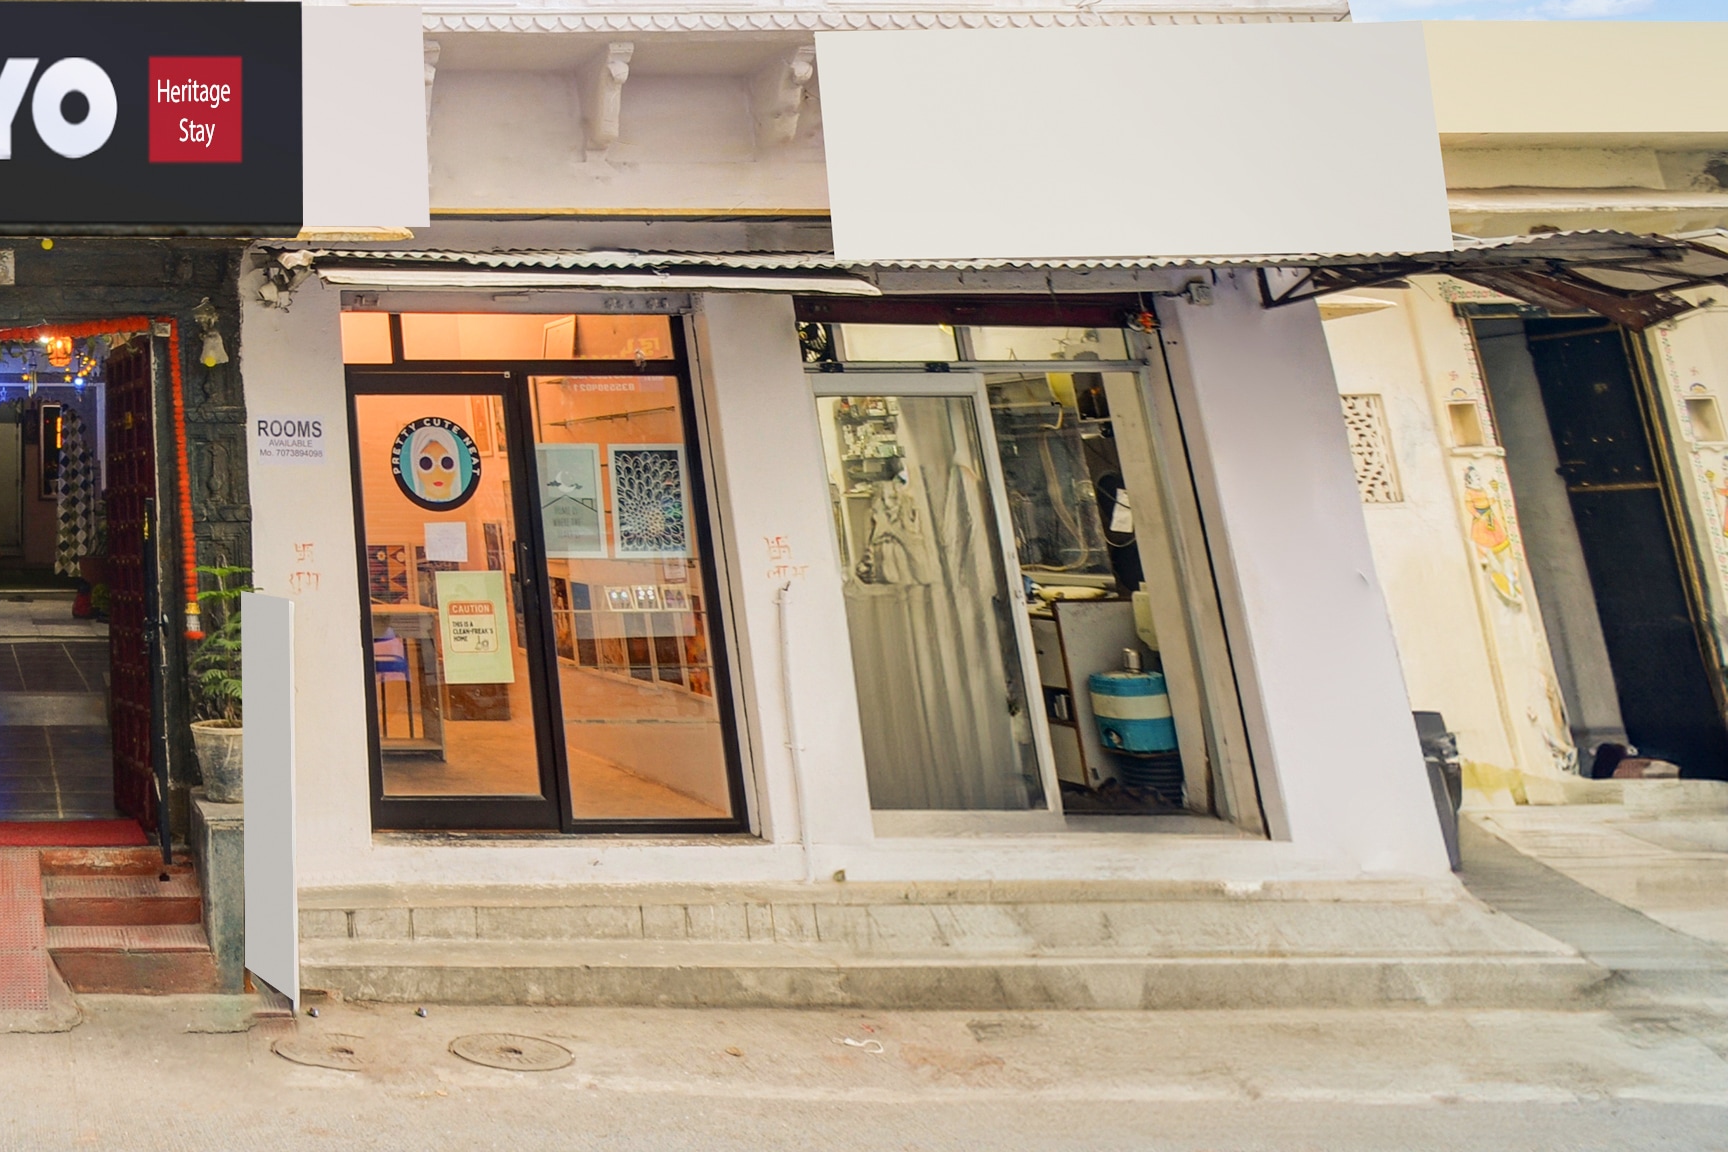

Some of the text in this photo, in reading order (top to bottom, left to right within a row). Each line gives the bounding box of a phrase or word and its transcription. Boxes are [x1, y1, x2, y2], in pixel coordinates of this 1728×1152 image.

[157, 78, 231, 109] Heritage
[178, 117, 216, 148] Stay
[257, 420, 322, 438] ROOMS
[268, 439, 313, 448] AVAILABLE
[392, 418, 480, 476] PRETTY CUTE NEAT
[452, 604, 490, 613] CAUTION
